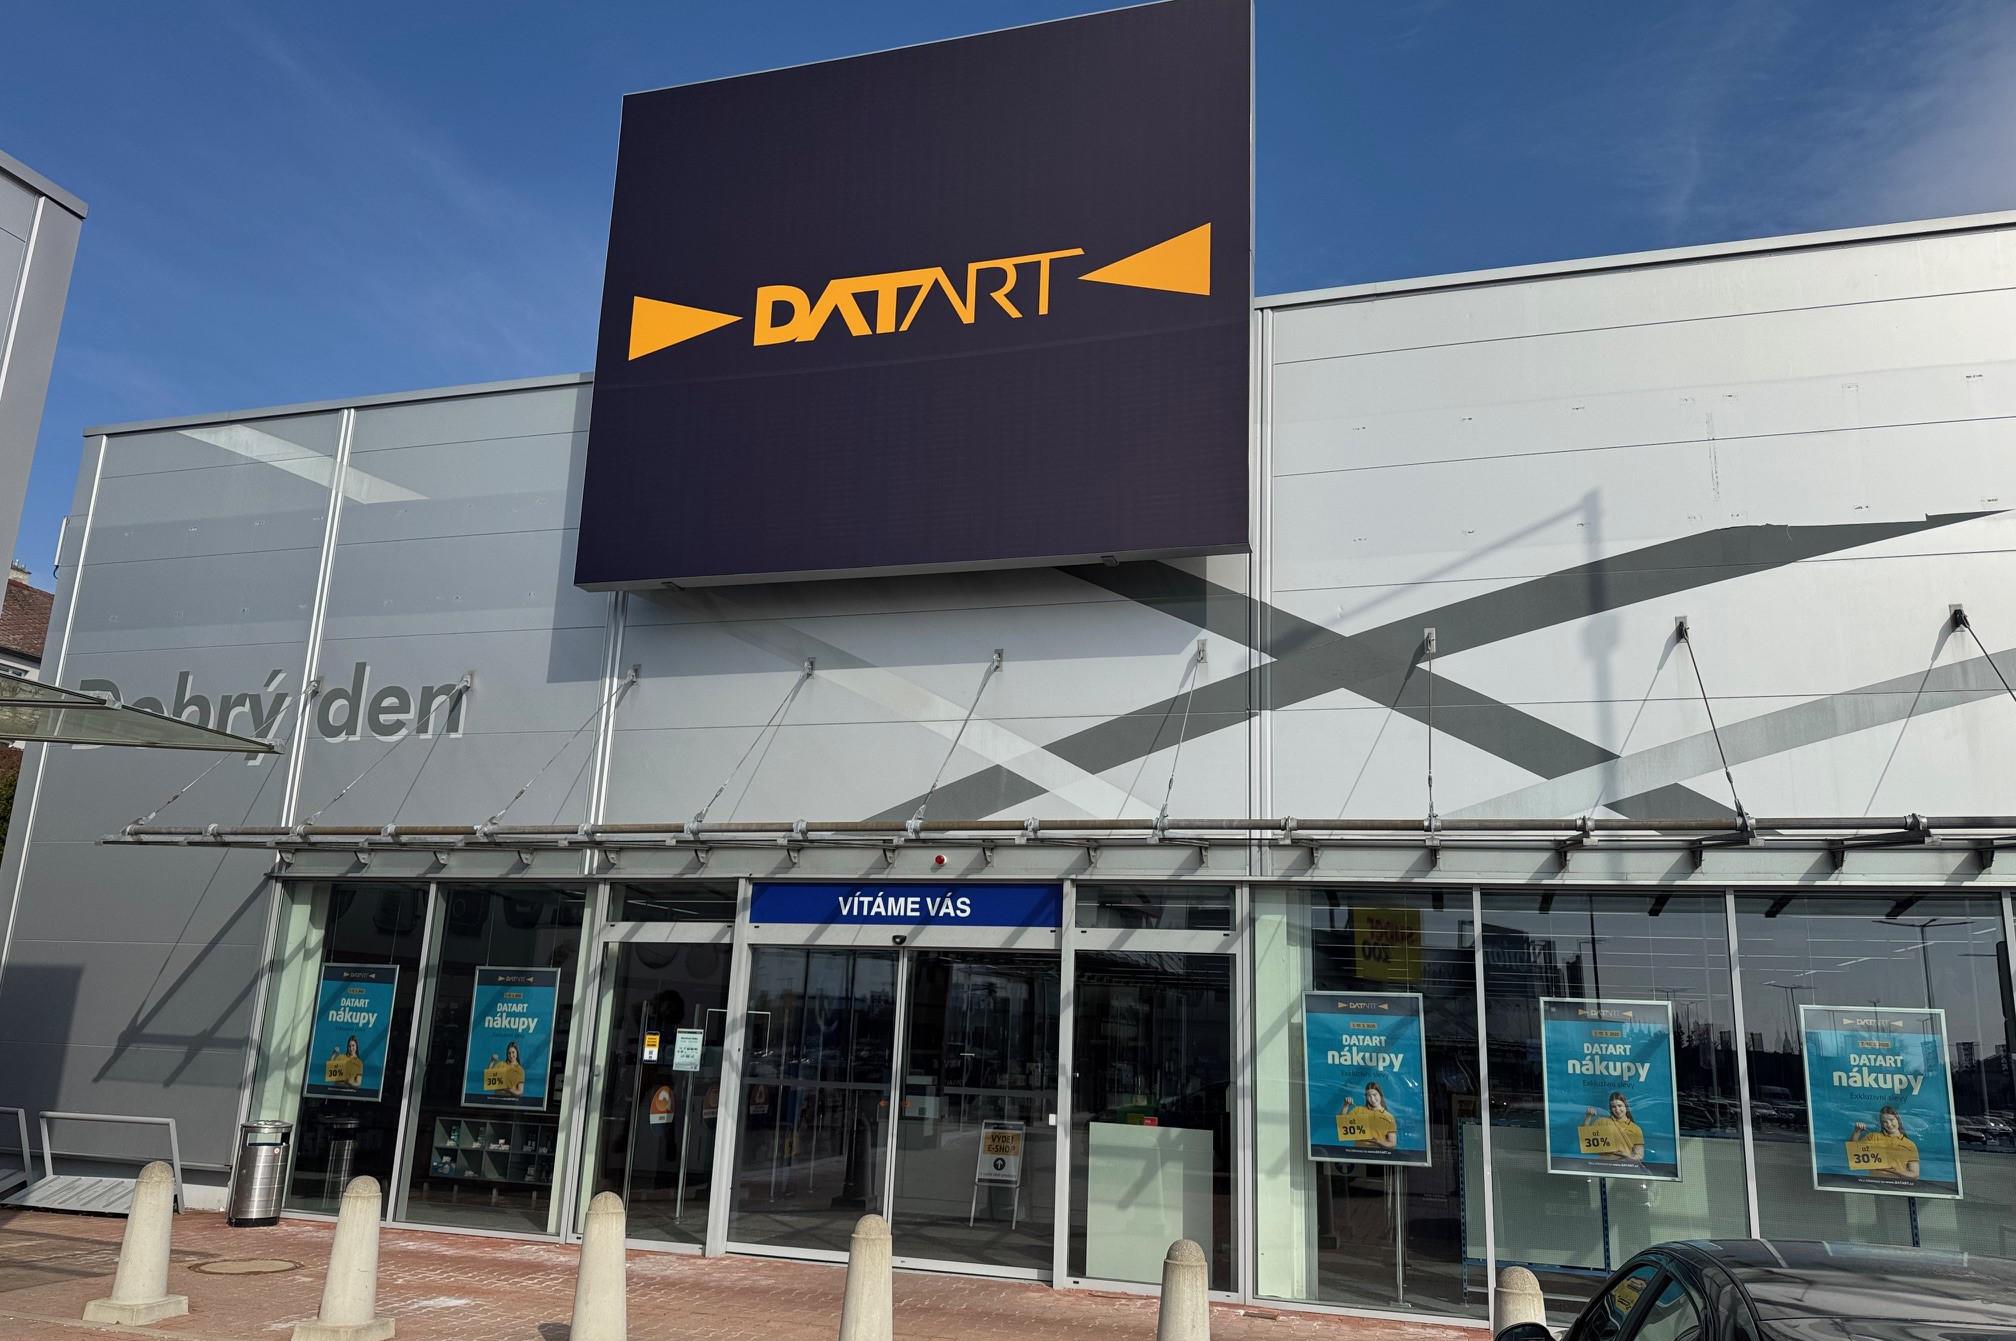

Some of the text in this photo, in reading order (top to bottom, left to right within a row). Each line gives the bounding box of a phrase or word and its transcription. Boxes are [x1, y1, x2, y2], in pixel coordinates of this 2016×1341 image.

[753, 248, 1085, 346] DATART
[317, 662, 467, 742] den
[838, 892, 971, 917] VÍTÁME VÁS
[341, 998, 369, 1008] DATART
[497, 1003, 528, 1013] DATART
[328, 1006, 377, 1028] nákupy
[484, 1013, 538, 1033] nákupy
[1342, 1034, 1386, 1047] DATART
[1583, 1043, 1632, 1056] DATART
[1327, 1046, 1404, 1072] nákupy
[1567, 1055, 1651, 1082] nákupy
[1849, 1054, 1903, 1067] DATART
[1832, 1067, 1923, 1095] nákupy
